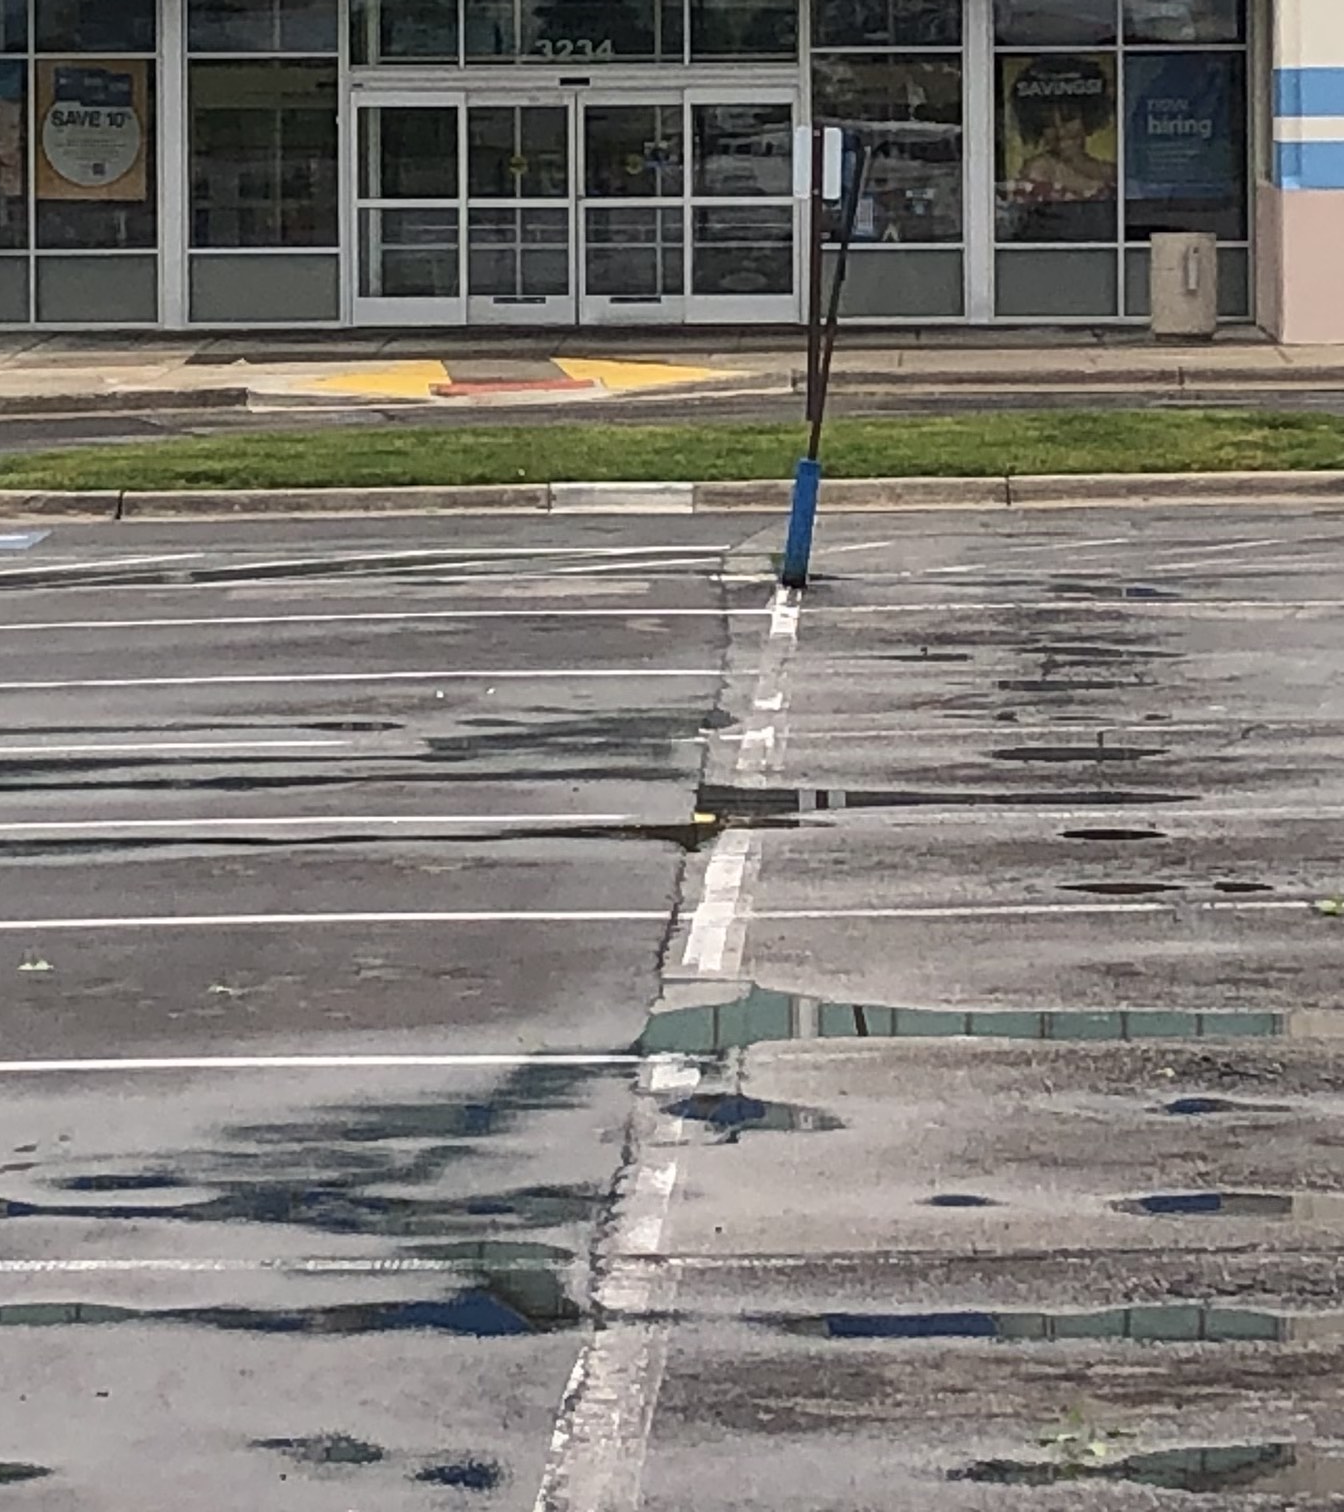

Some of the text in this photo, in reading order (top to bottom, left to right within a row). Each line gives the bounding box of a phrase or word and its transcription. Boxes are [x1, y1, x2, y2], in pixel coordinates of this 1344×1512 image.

[535, 39, 615, 60] 3234
[51, 110, 101, 128] SAVE
[1148, 114, 1213, 140] hiring
